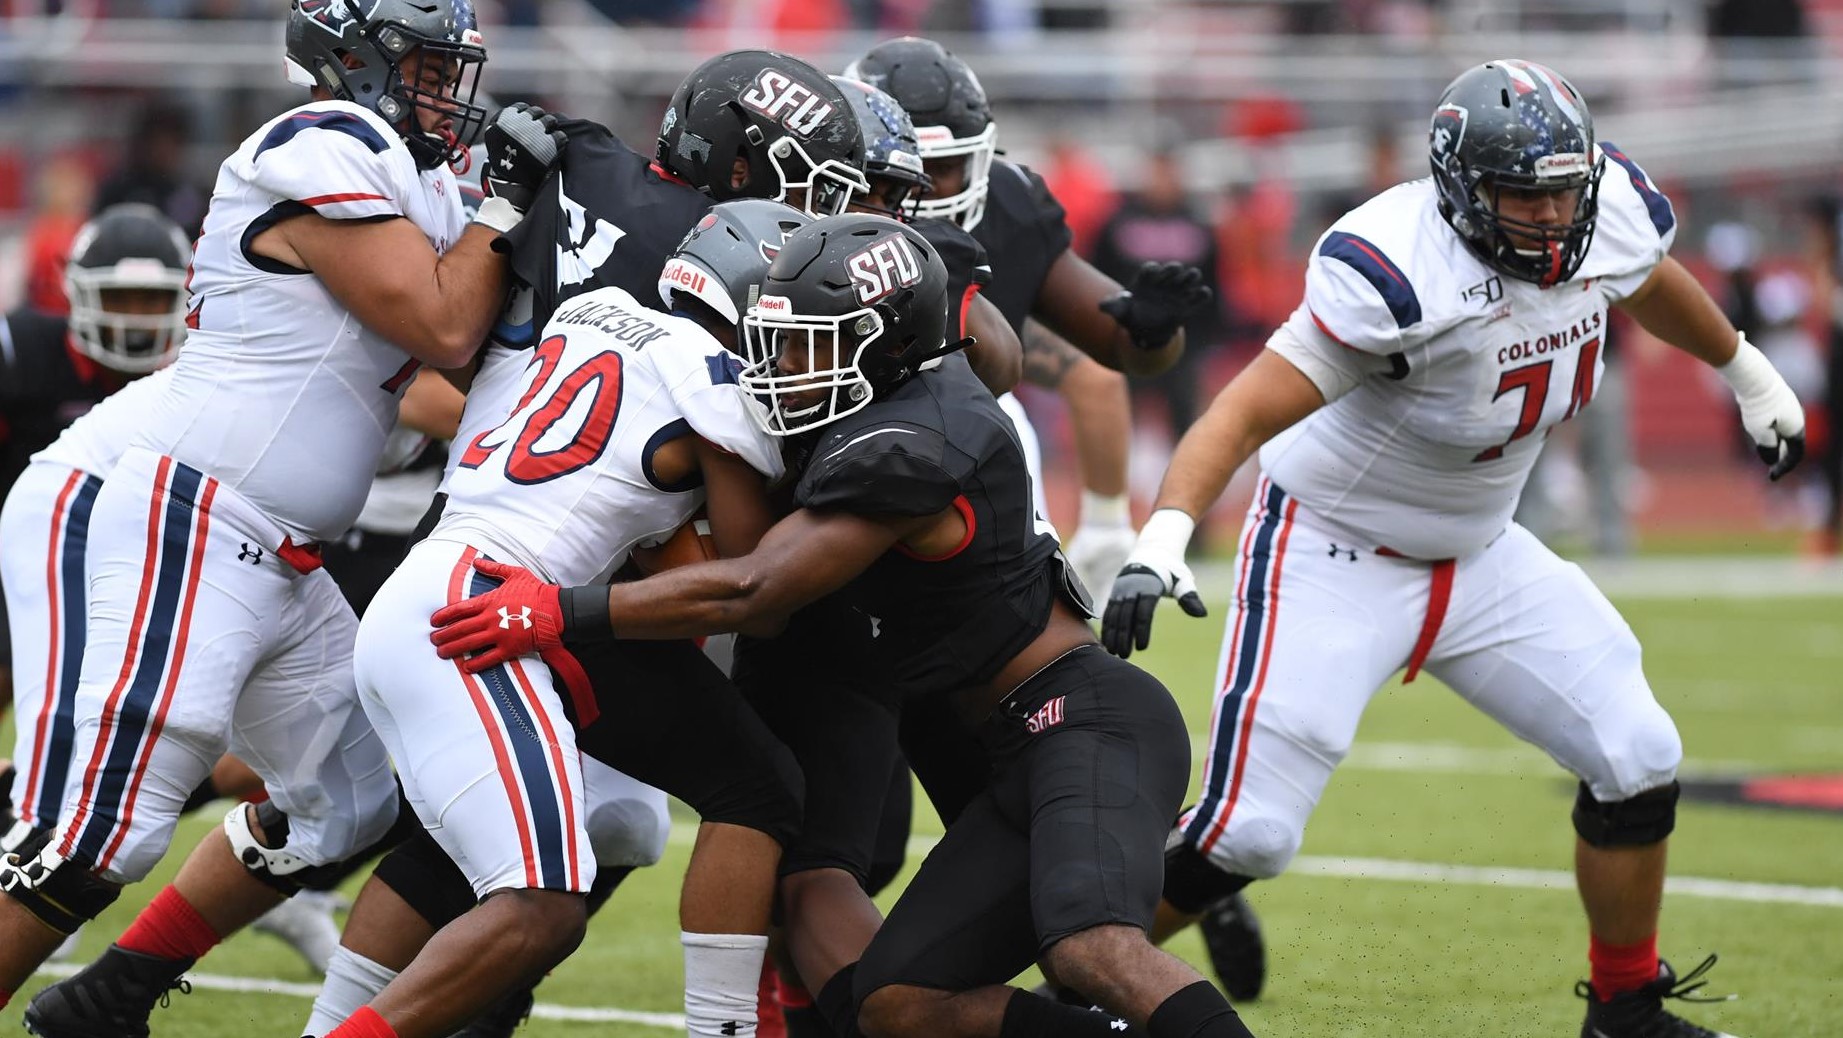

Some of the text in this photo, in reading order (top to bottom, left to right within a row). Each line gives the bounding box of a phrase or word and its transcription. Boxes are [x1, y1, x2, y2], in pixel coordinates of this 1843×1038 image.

[742, 70, 834, 136] SFU
[848, 235, 920, 304] SFU
[1461, 275, 1504, 310] 150
[556, 300, 671, 352] JACKSON
[759, 298, 785, 310] Riddell
[1497, 311, 1601, 365] COLONIALS
[458, 333, 624, 486] 20
[1025, 695, 1066, 734] SFU
